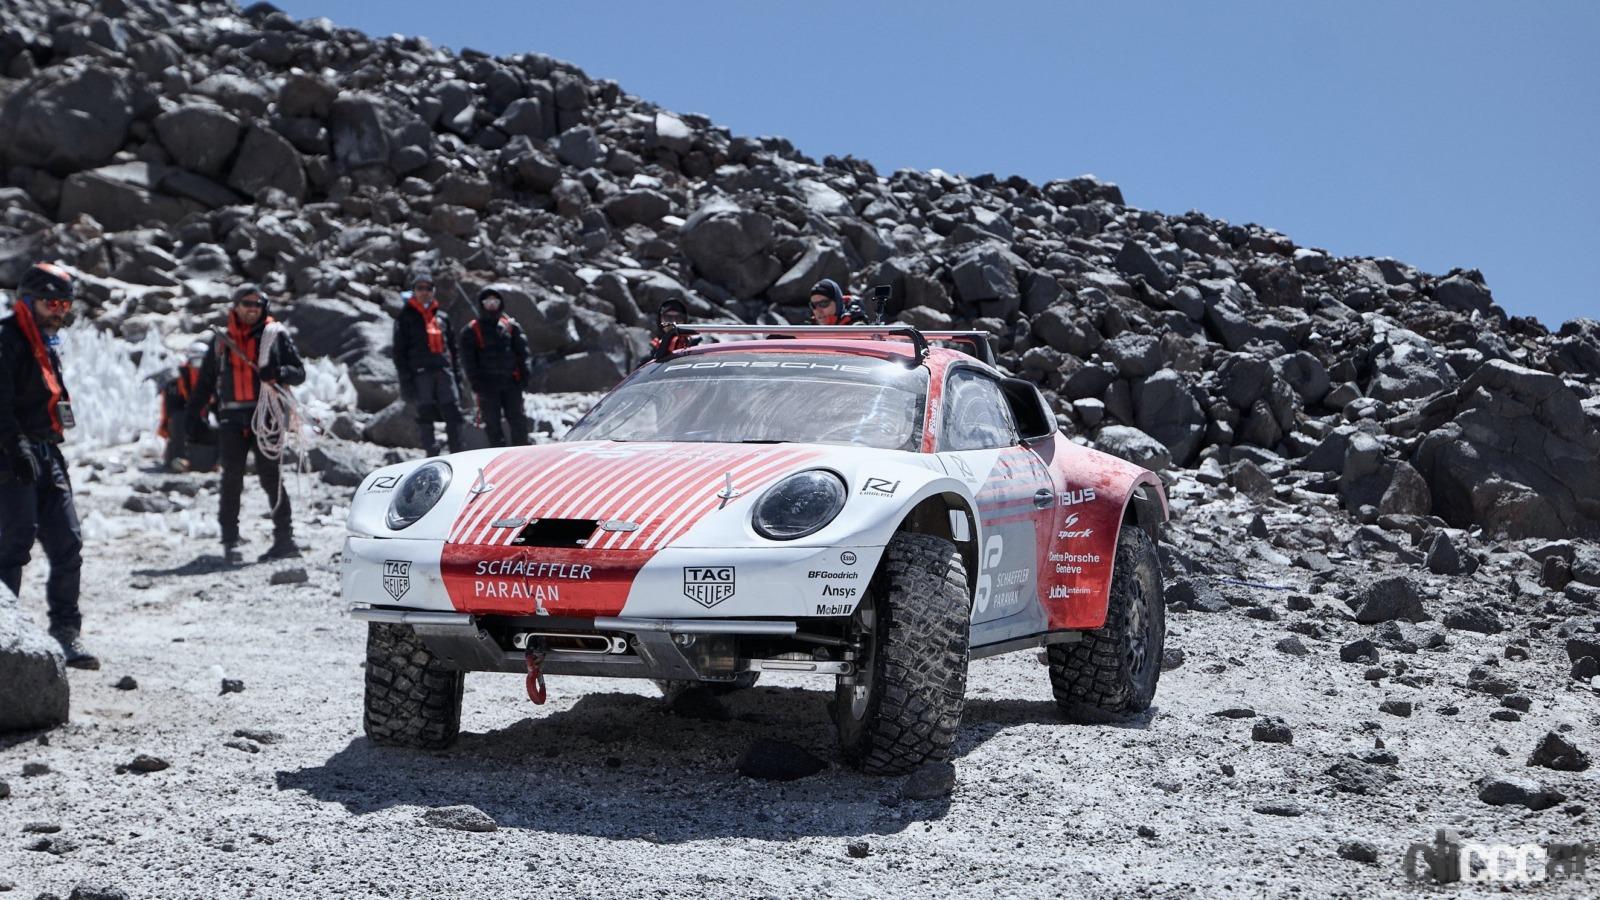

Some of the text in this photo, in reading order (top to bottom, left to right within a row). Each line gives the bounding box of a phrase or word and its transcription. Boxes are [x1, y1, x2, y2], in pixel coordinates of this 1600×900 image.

[664, 361, 872, 375] PORSCHE
[1058, 528, 1094, 539] spark
[1064, 552, 1100, 563] Porsche
[386, 562, 408, 575] TAG
[475, 560, 592, 580] SCHAEFFLER
[688, 568, 731, 581] TAG
[807, 570, 858, 579] BFGoodrich
[1056, 563, 1082, 574] Genève
[384, 578, 408, 598] HEUER
[474, 581, 560, 601] PARAVAN
[822, 584, 857, 599] Ansys
[687, 585, 732, 605] HEUER
[816, 604, 843, 615] Mobil
